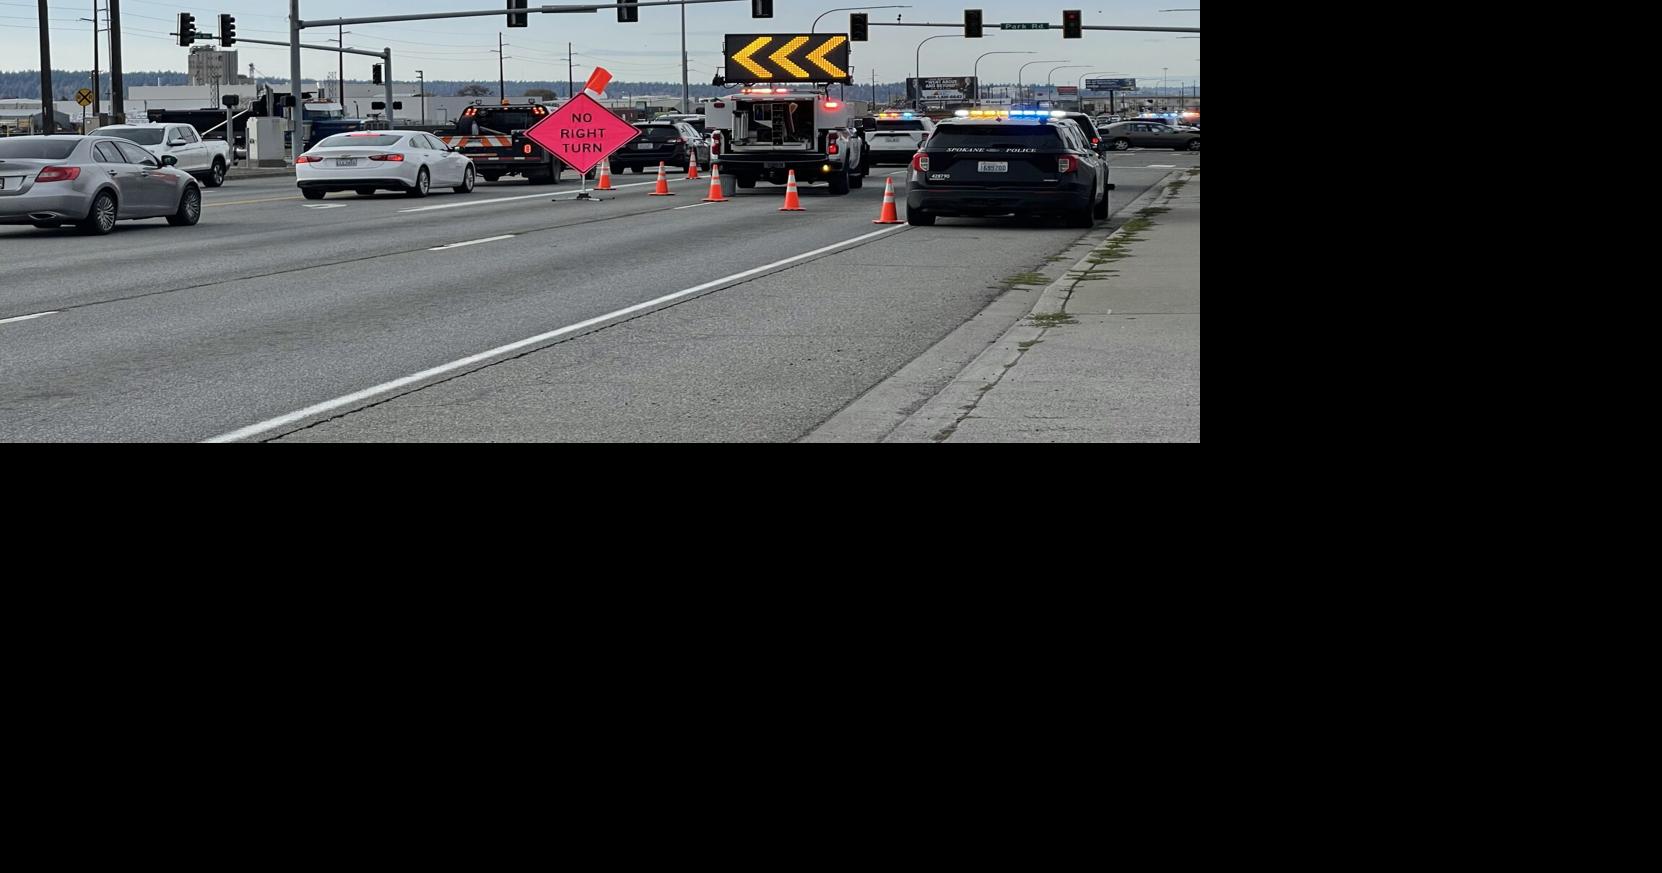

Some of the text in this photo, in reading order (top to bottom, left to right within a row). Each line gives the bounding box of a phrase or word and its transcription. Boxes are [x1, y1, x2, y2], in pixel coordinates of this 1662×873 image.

[572, 112, 592, 123] NO
[560, 128, 605, 139] RIGHT
[562, 143, 602, 153] TURN
